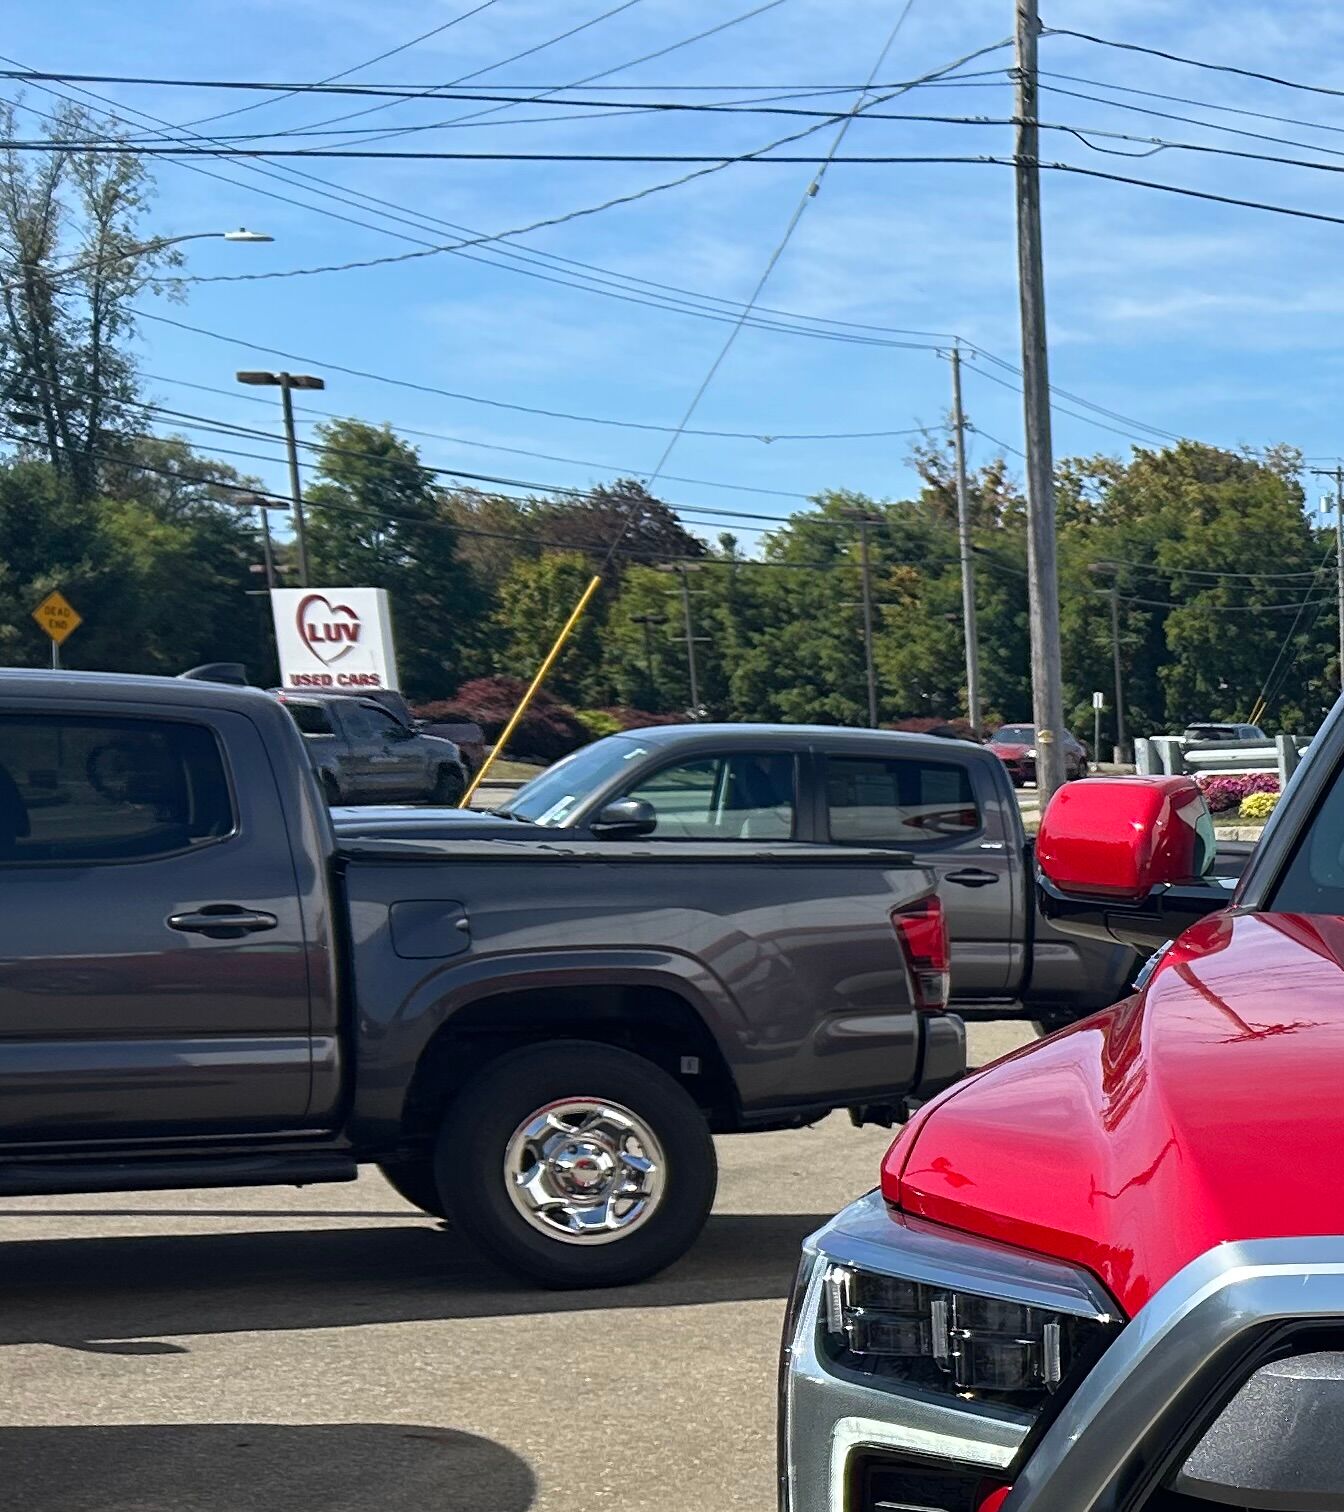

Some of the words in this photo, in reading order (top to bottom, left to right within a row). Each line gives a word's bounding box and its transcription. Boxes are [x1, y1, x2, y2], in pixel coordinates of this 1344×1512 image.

[307, 622, 361, 643] LUV
[289, 672, 333, 687] USED
[336, 673, 382, 687] CARS
